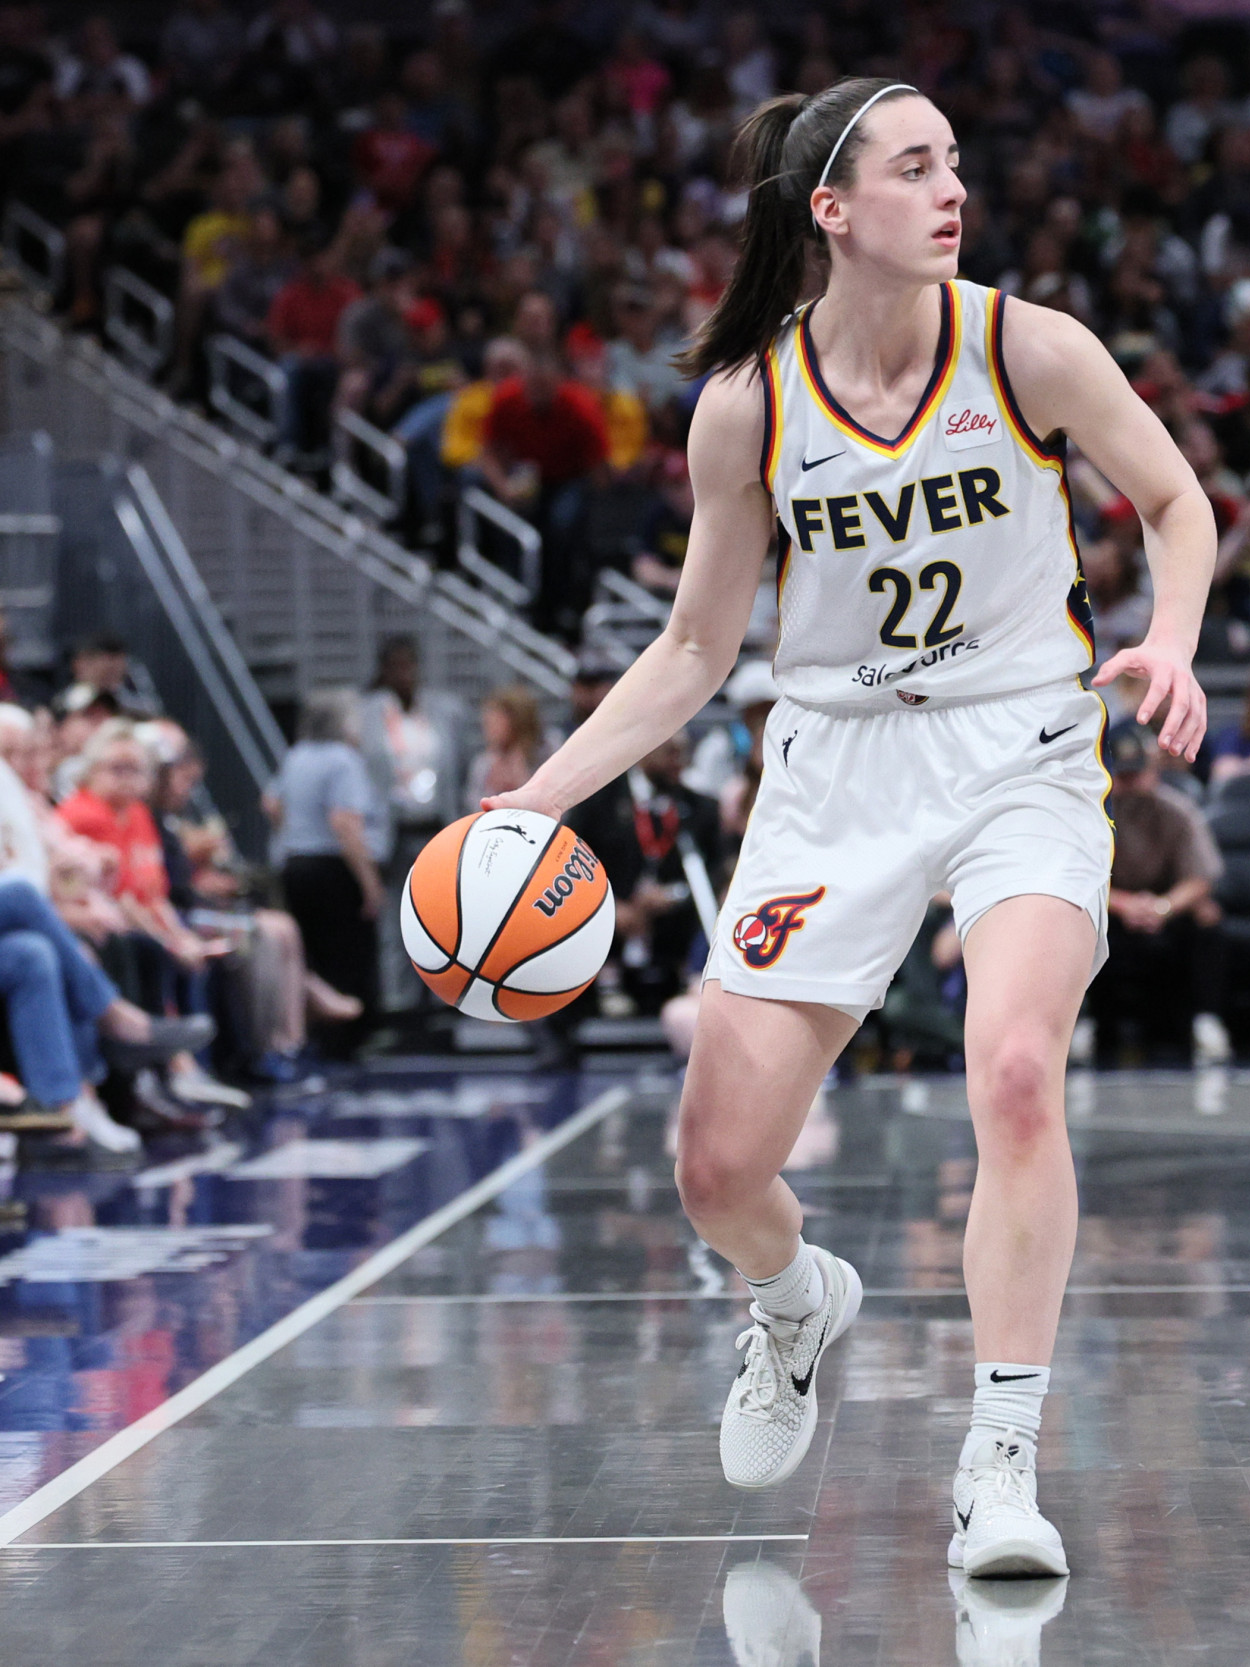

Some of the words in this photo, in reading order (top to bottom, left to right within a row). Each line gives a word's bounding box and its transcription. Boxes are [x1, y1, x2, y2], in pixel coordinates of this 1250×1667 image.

[945, 409, 997, 435] Lilly
[791, 466, 1011, 553] FEVER
[868, 560, 964, 649] 22
